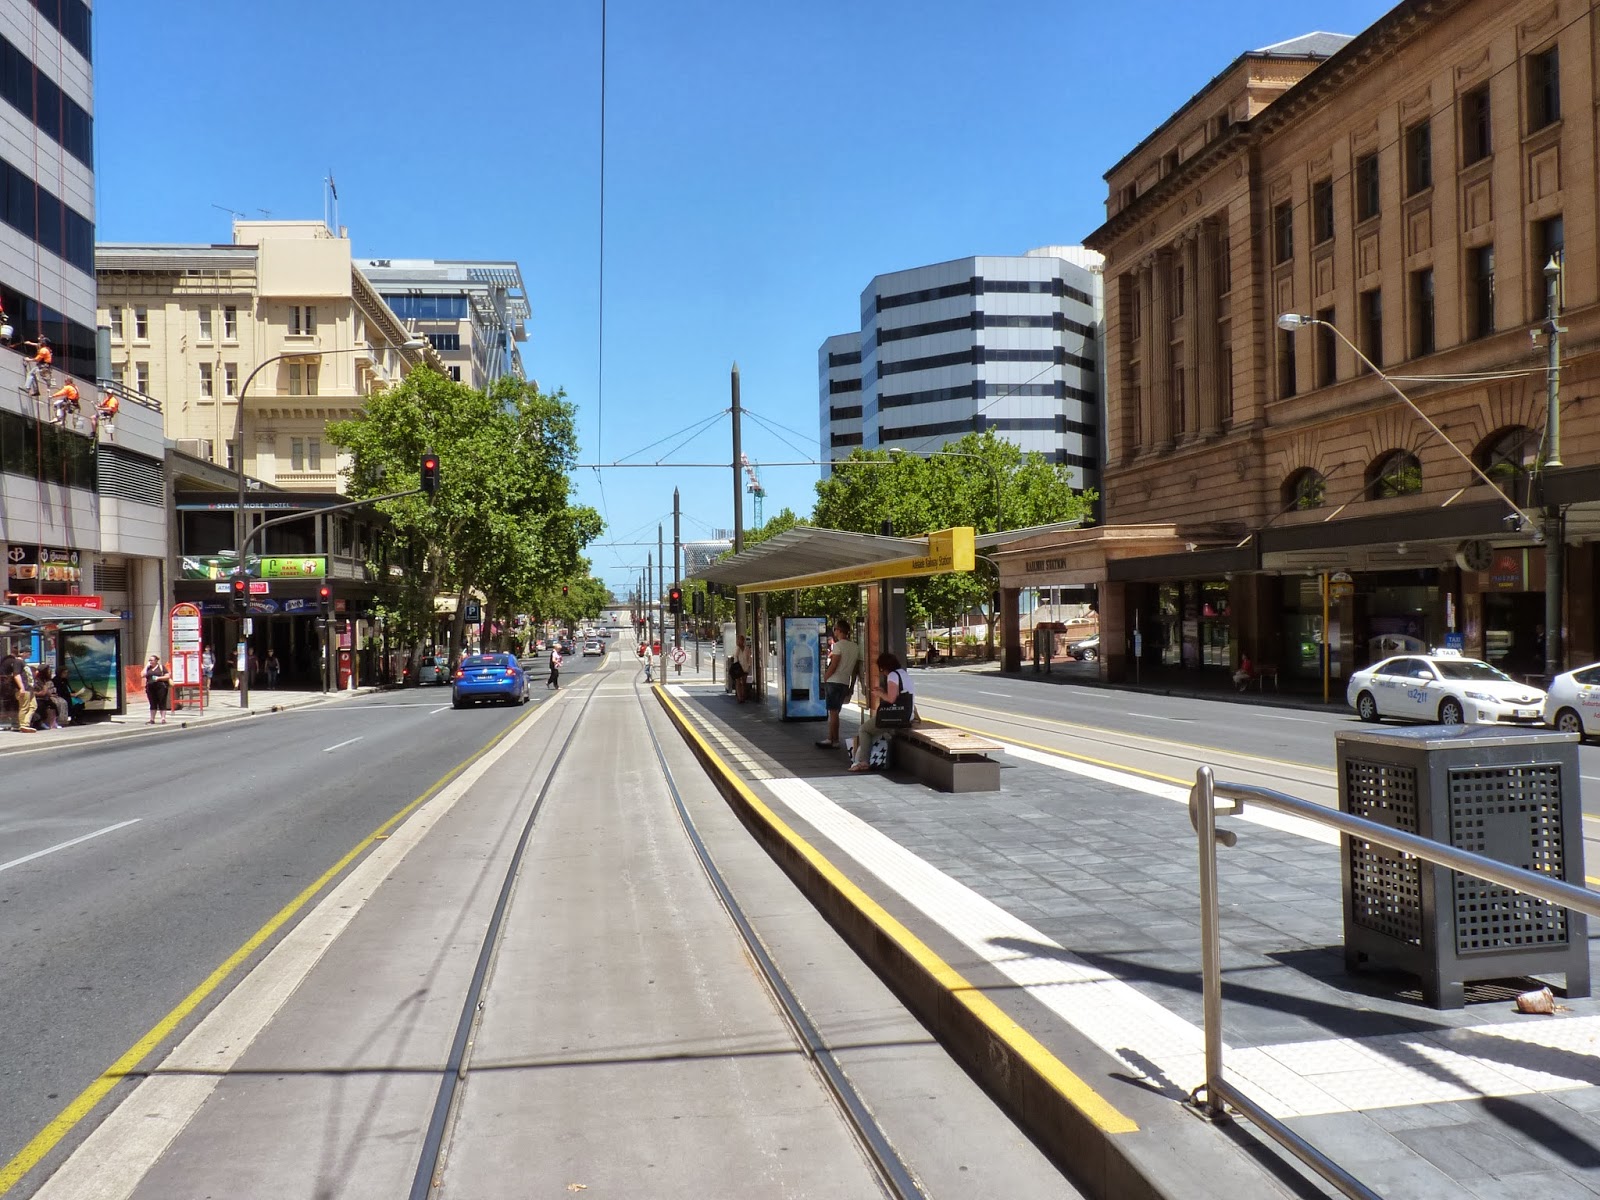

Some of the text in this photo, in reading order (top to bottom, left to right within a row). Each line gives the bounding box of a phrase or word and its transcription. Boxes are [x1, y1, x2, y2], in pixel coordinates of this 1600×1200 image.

[939, 555, 952, 566] Station
[1026, 557, 1067, 572] RAILWAY STATION
